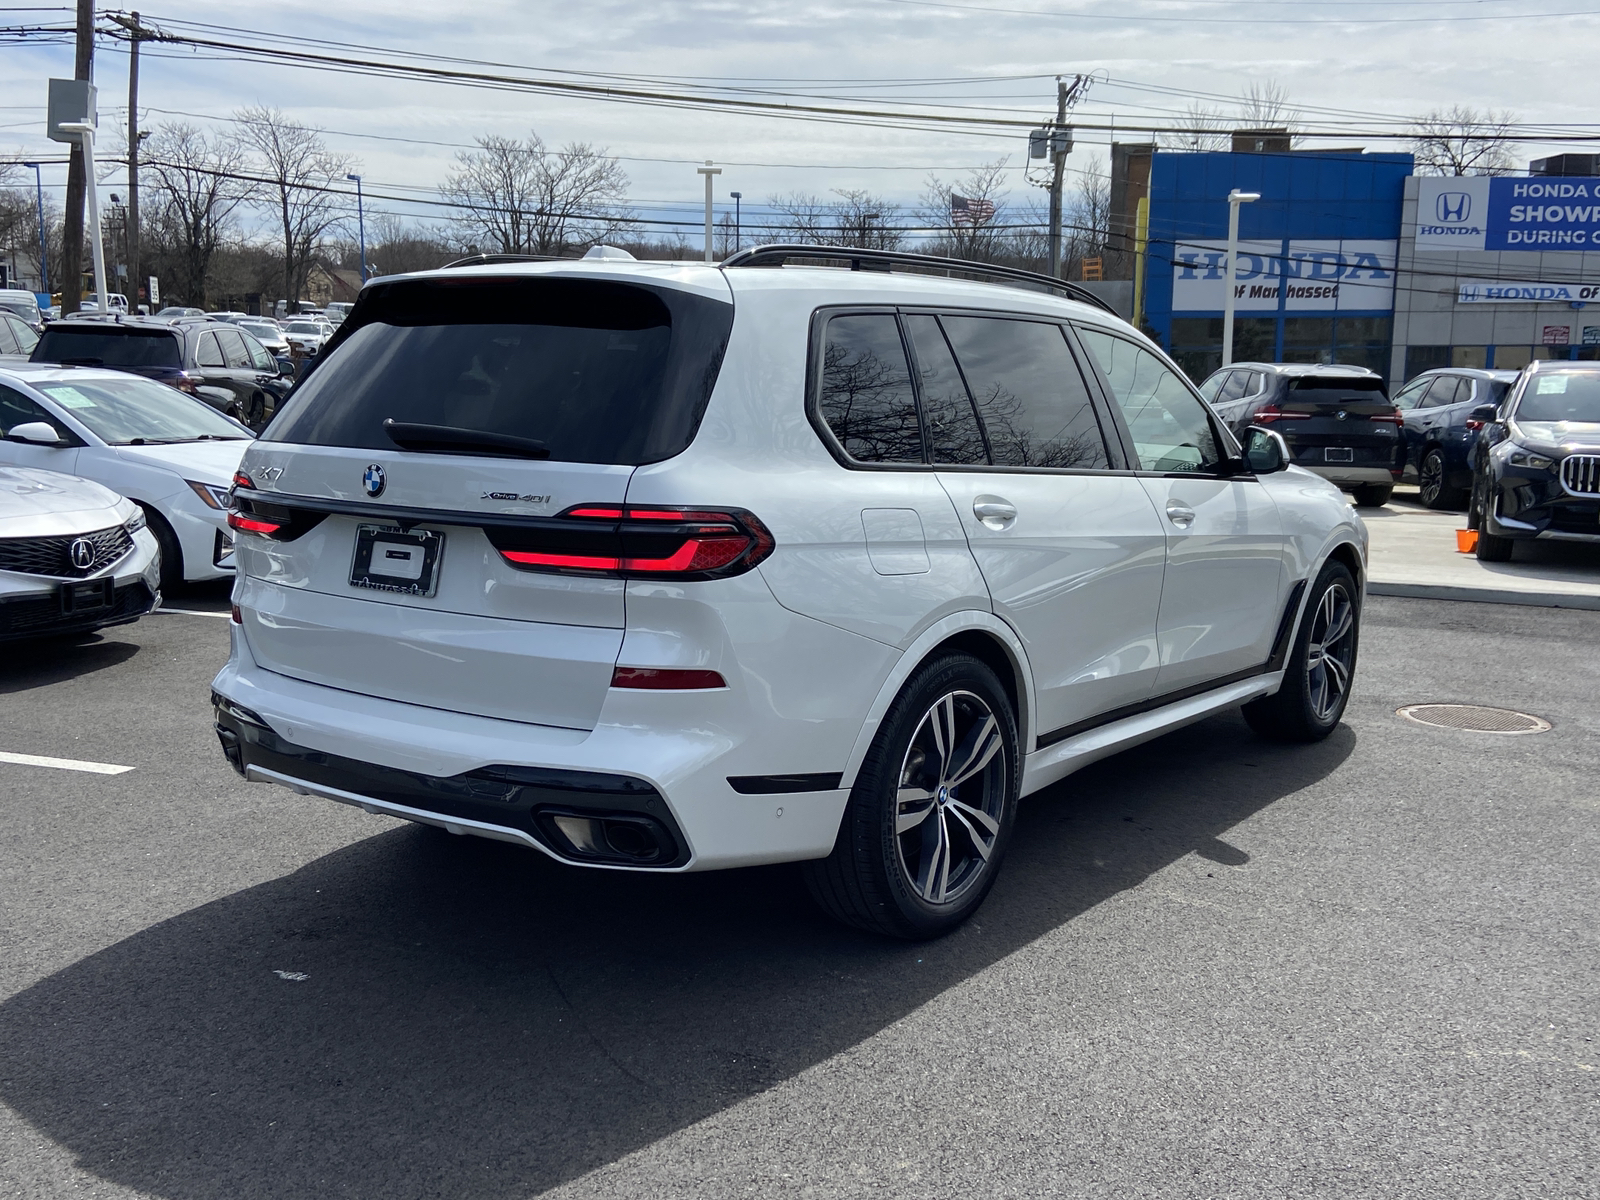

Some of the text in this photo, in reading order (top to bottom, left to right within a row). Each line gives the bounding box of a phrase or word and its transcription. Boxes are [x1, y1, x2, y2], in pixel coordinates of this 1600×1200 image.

[1513, 183, 1589, 198] HONDA
[1420, 226, 1481, 235] HONDA
[1507, 230, 1586, 244] DURING
[1178, 252, 1390, 280] HONDA
[1249, 284, 1340, 299] Manhasset
[1485, 286, 1600, 299] HONDA Of
[259, 466, 284, 481] X7
[350, 580, 429, 597] MANHASSET
